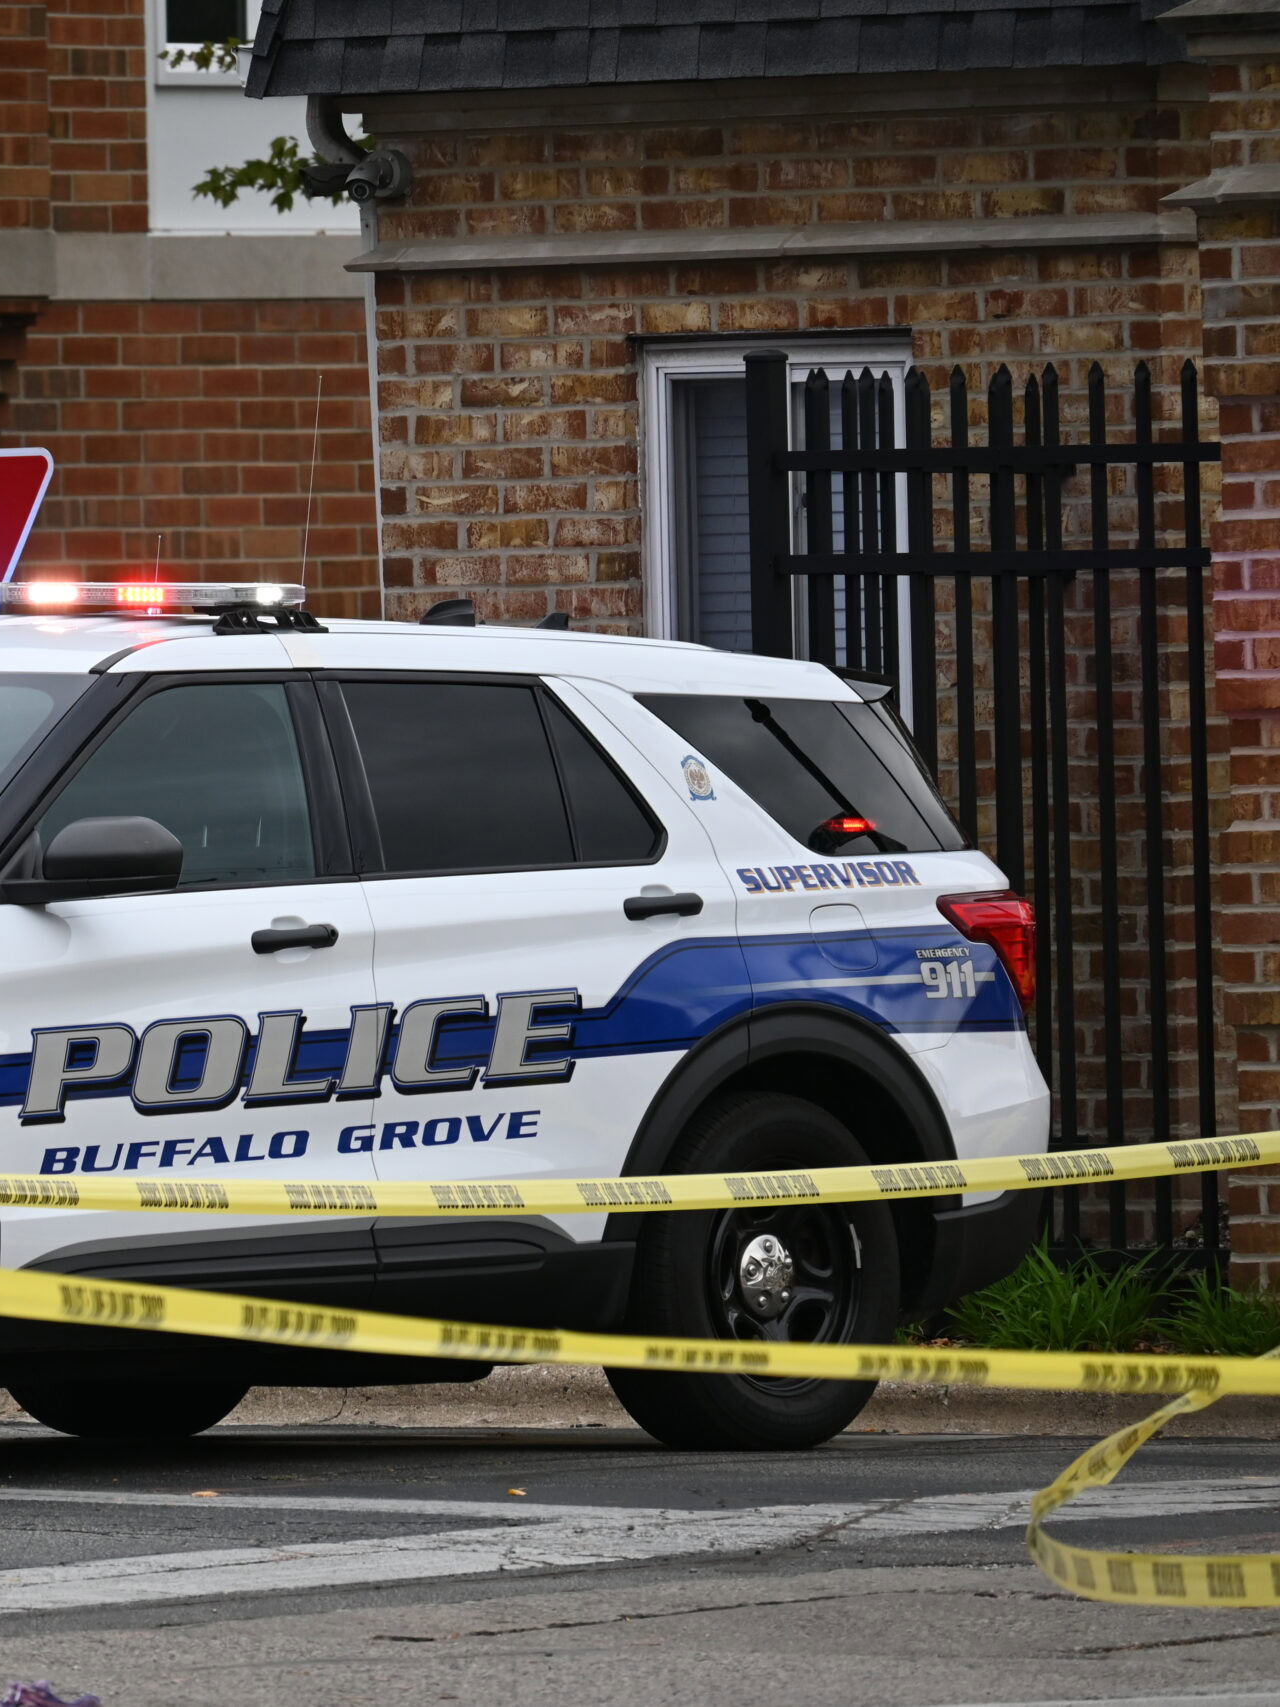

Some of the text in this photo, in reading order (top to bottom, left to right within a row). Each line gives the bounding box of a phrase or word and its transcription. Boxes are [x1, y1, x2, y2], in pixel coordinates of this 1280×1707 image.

[736, 861, 922, 894] SUPERVISOR
[915, 947, 970, 959] EMERGENCY
[920, 960, 977, 998] 911
[18, 986, 582, 1127] POLICE
[39, 1110, 541, 1175] BUFFALO GROVE
